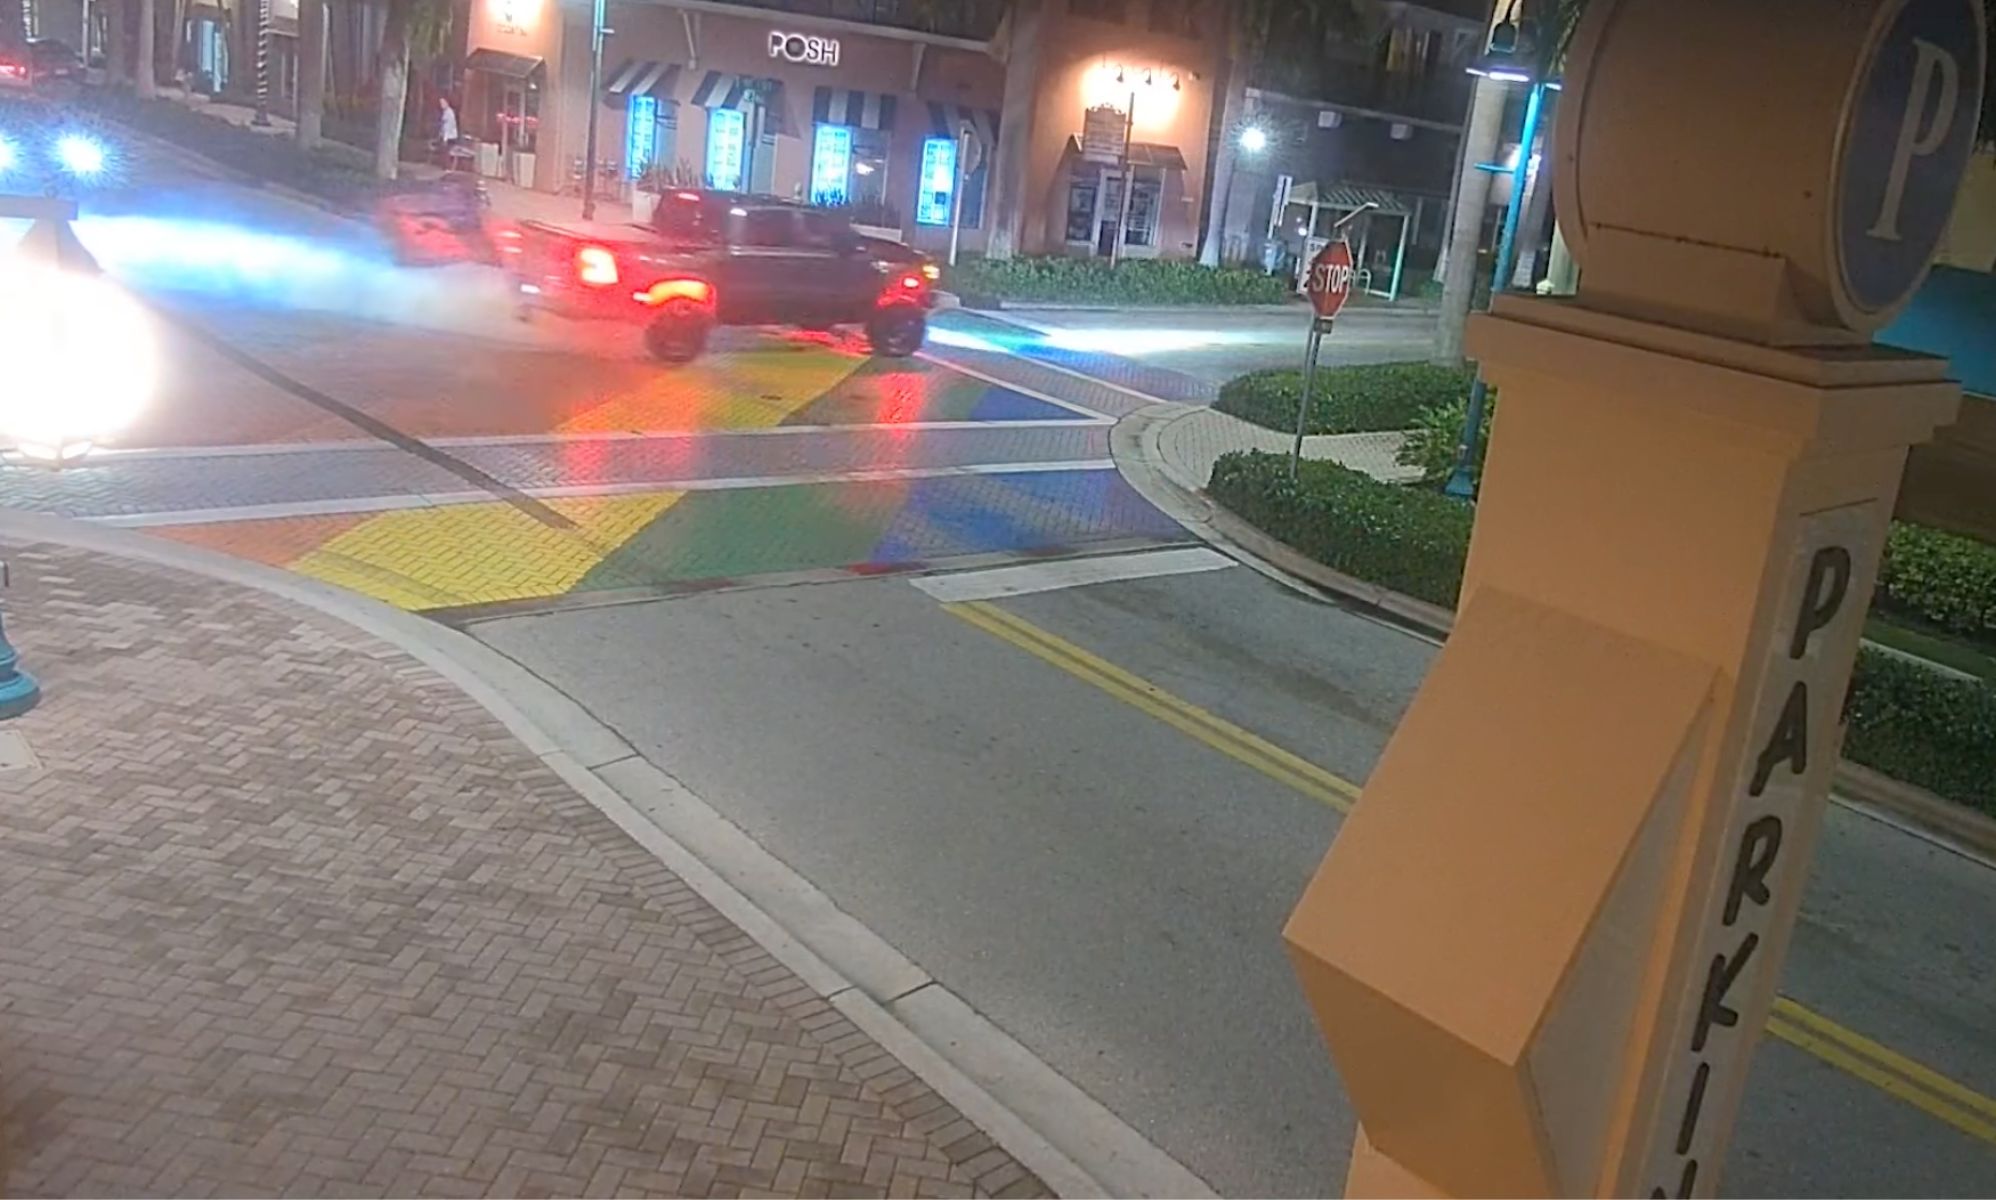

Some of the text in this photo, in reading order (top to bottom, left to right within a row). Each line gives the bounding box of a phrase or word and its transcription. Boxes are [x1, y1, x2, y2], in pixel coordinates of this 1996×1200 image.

[768, 31, 840, 66] POSH
[1866, 36, 1959, 241] P
[1312, 263, 1349, 293] STOP
